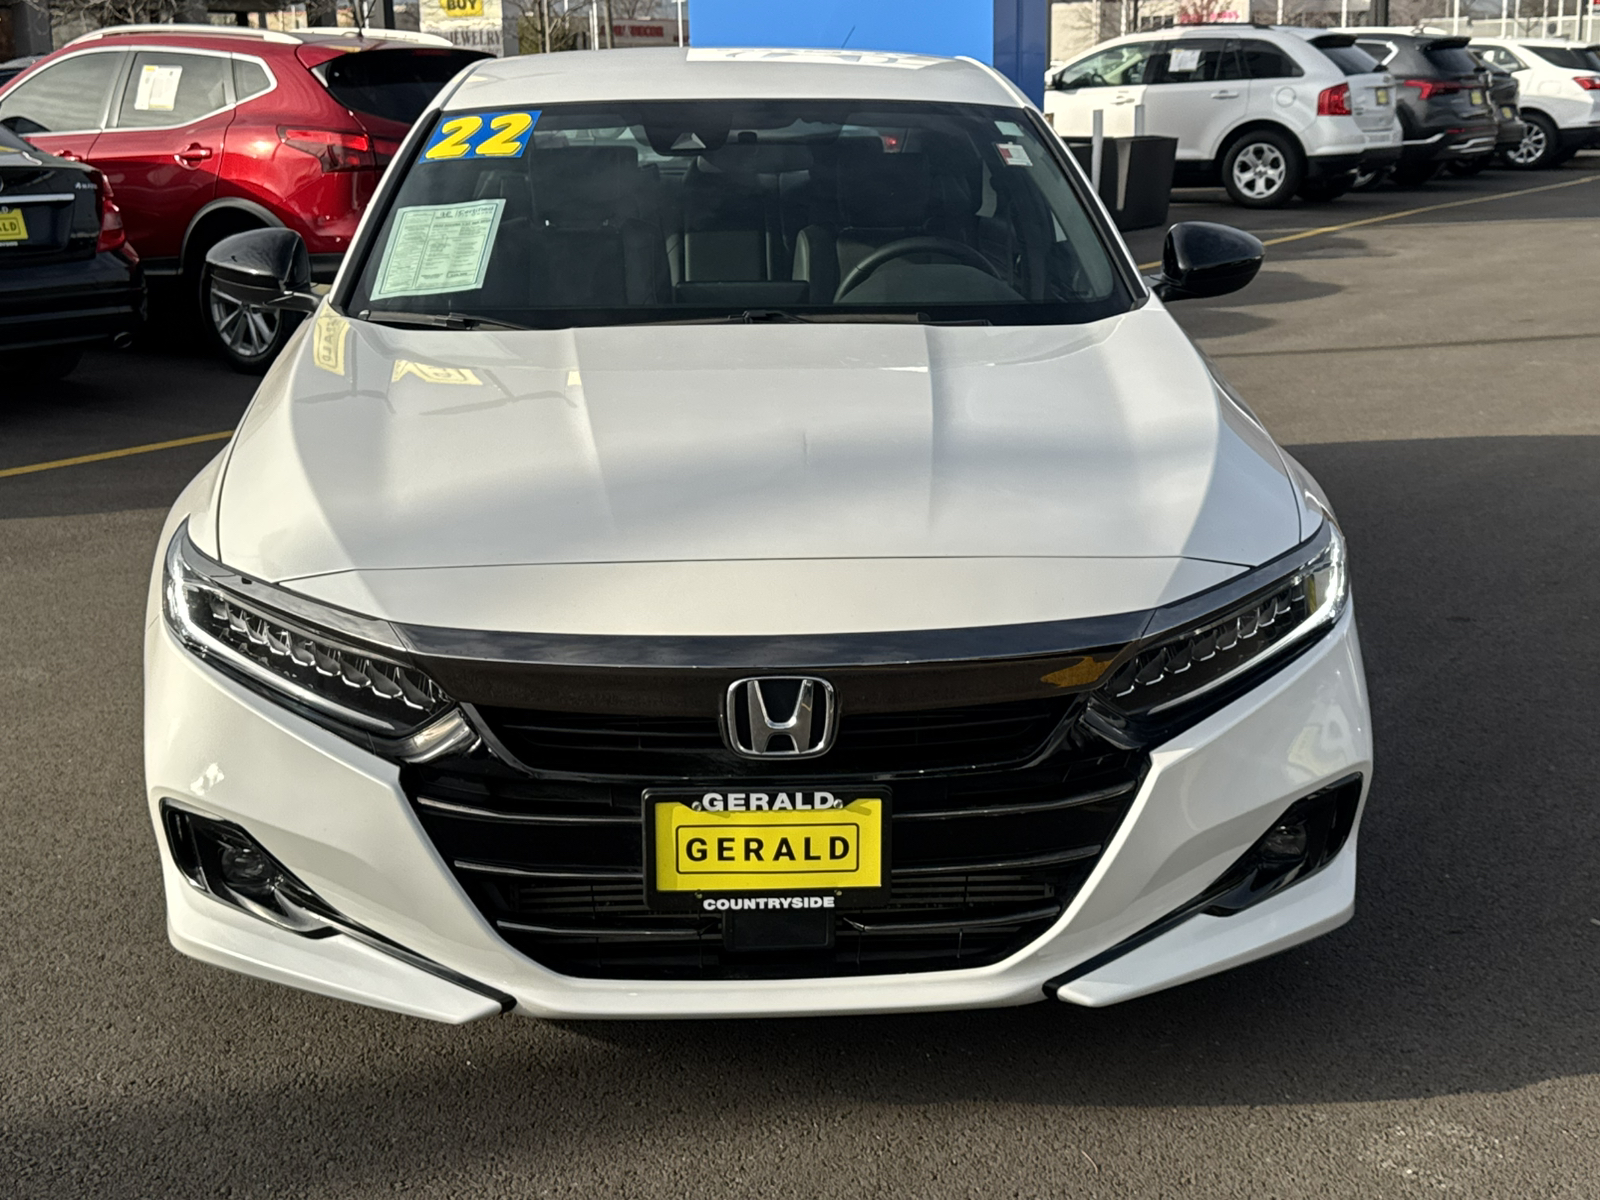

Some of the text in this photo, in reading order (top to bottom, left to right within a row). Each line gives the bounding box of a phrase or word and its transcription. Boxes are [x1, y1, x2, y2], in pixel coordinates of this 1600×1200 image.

[425, 113, 532, 159] 22
[702, 791, 834, 812] GERALD
[685, 836, 850, 862] GERALD
[703, 896, 835, 911] COUNTRYSIDE
